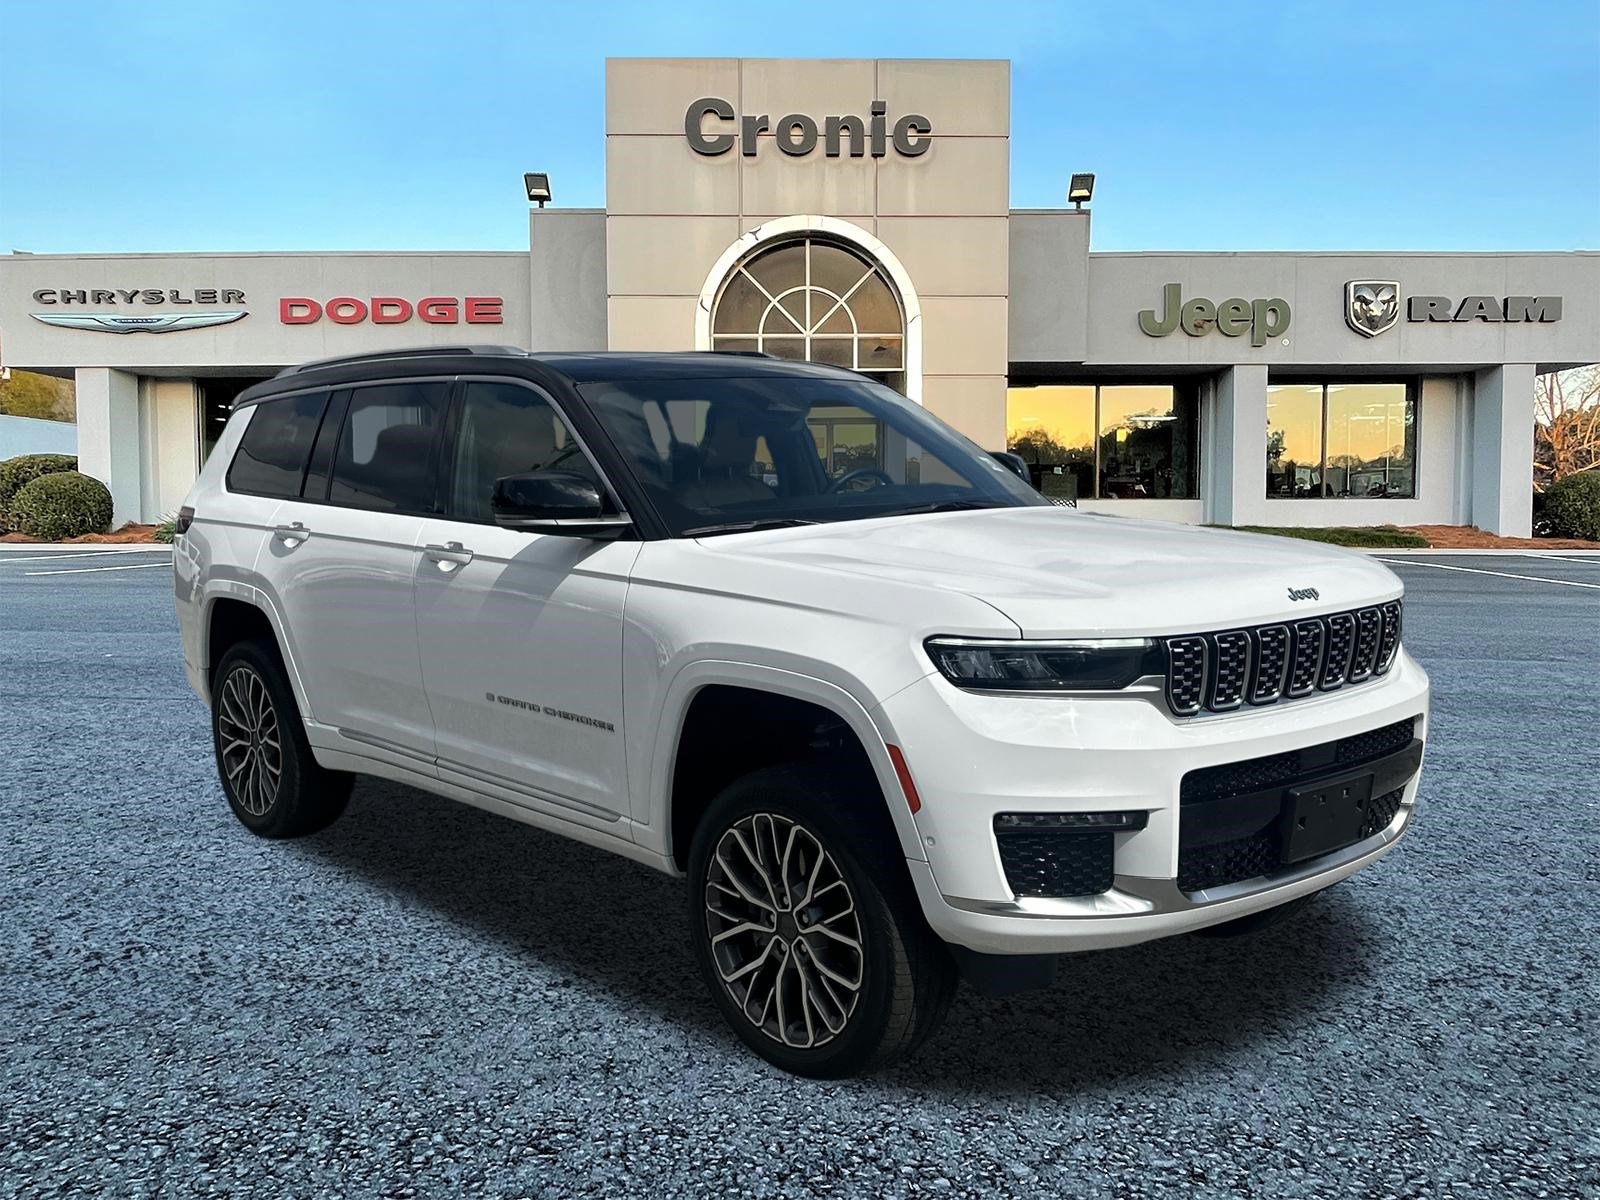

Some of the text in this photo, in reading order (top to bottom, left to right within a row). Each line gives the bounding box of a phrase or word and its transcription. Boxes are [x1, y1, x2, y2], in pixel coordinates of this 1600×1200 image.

[685, 97, 932, 157] Cronic
[32, 289, 246, 305] CHRYSLER
[280, 297, 504, 325] DODGE
[1407, 296, 1563, 322] RAM
[1138, 283, 1291, 347] Jeep
[1287, 587, 1320, 602] Jeep
[497, 695, 615, 732] GRAND CHEROKEE
